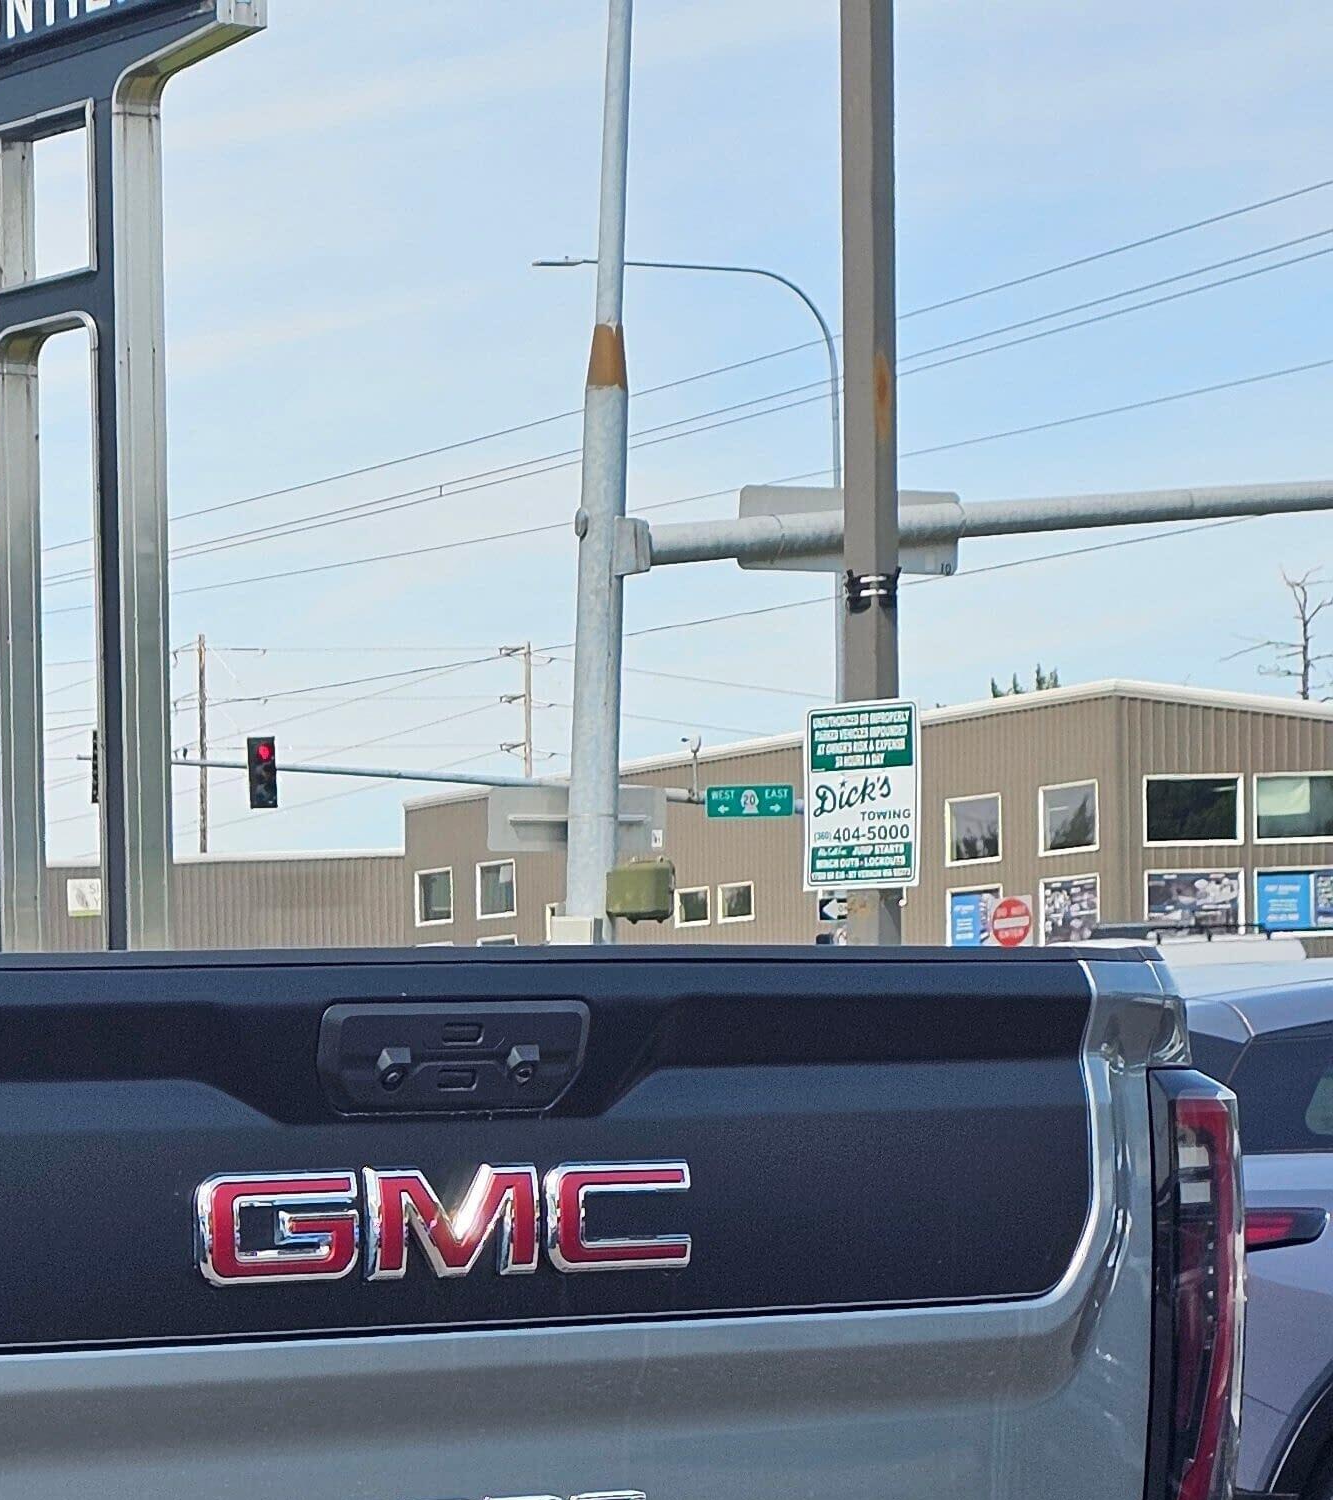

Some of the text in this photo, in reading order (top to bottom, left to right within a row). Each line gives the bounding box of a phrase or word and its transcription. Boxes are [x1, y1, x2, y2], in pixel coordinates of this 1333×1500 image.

[711, 789, 789, 805] WEST 20 EAST
[813, 775, 892, 818] Dick's
[861, 809, 912, 821] TOWING
[833, 824, 910, 842] 404-5000
[196, 1160, 691, 1288] GMC
